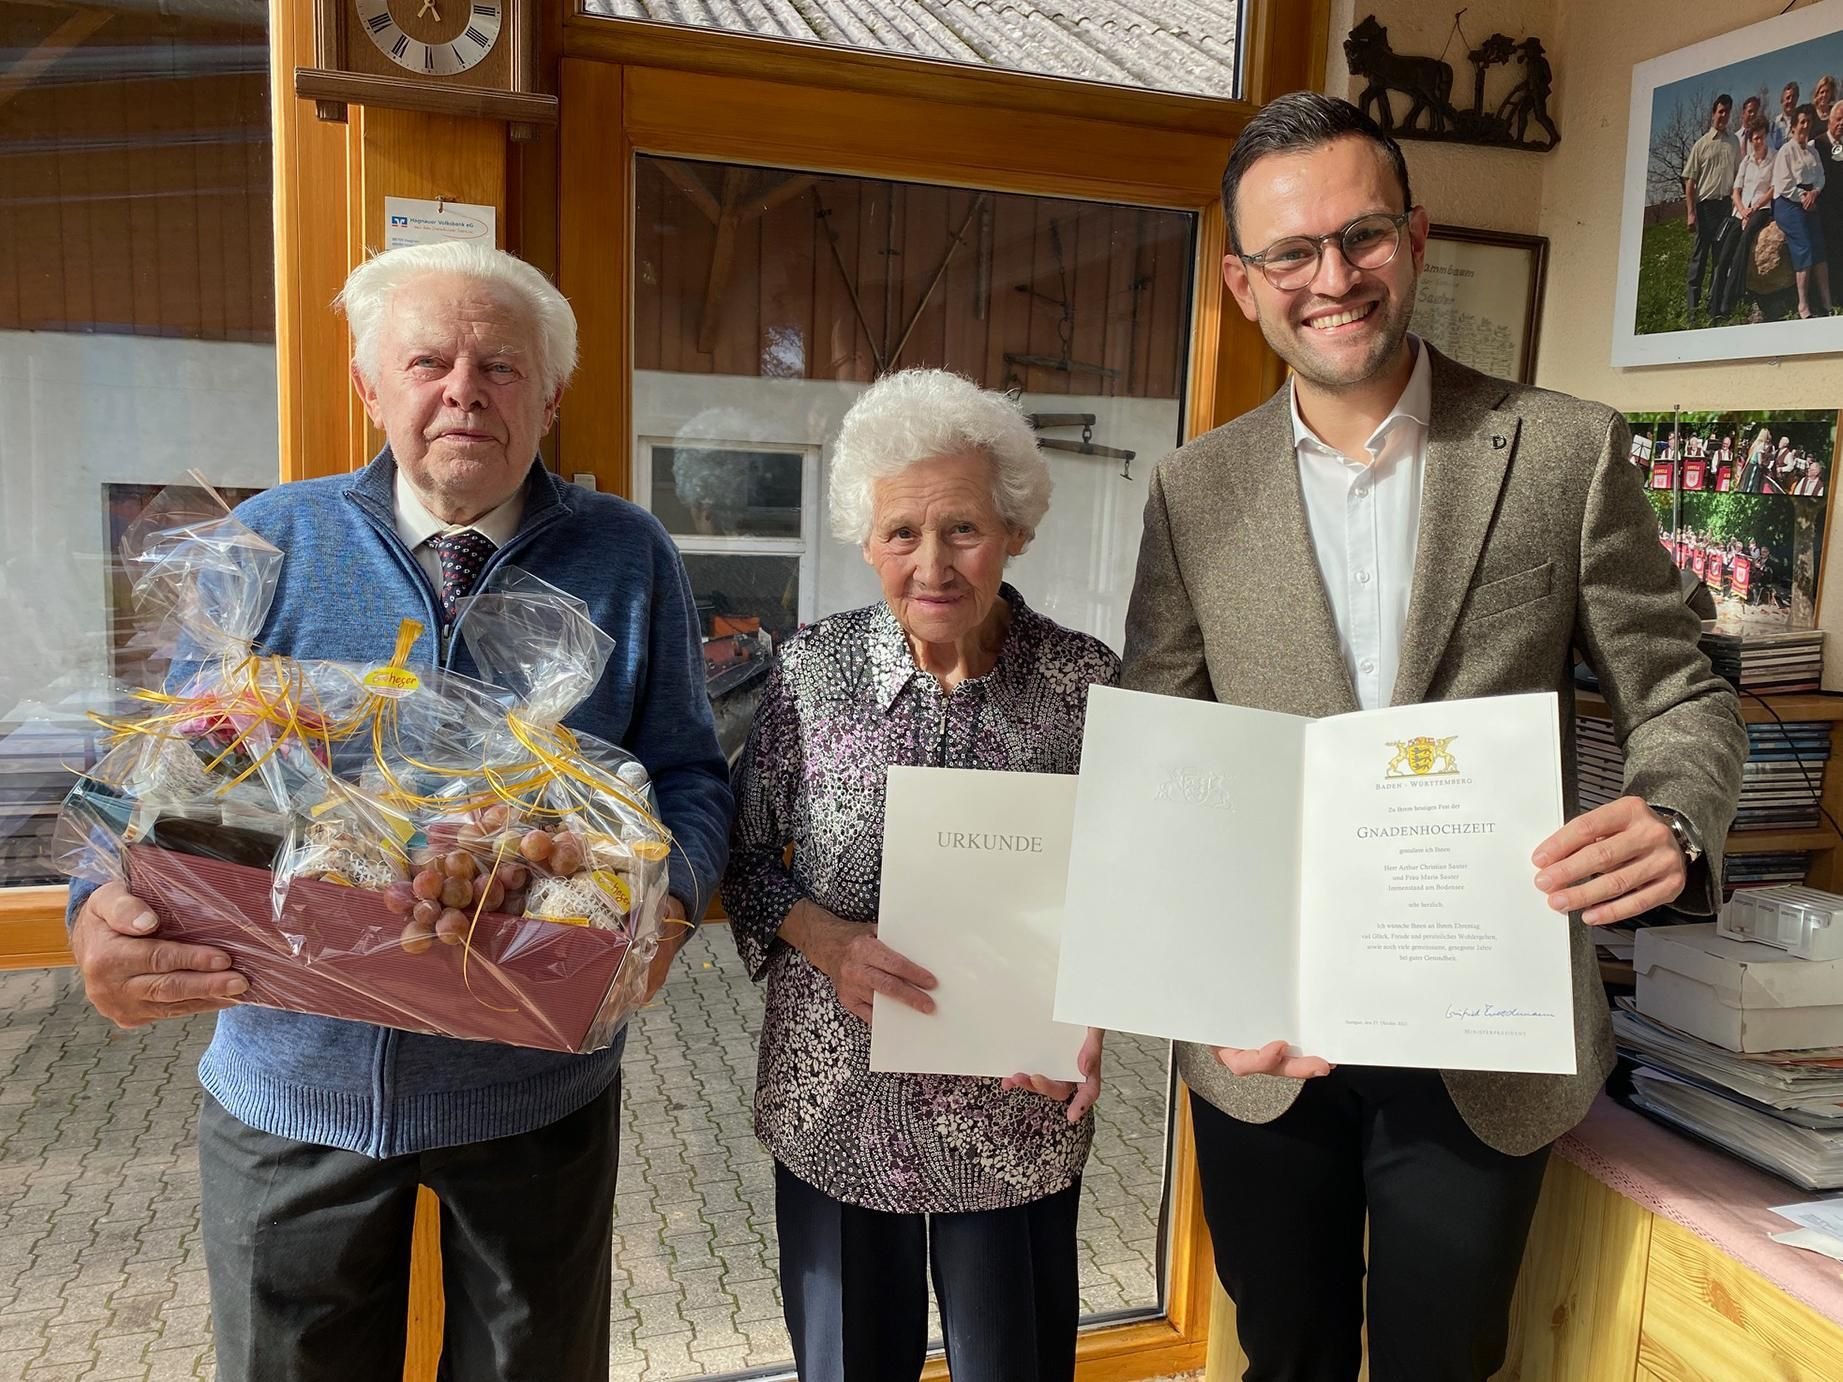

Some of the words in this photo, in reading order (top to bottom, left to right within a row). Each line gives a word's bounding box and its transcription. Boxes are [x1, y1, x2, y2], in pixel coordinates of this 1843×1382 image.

[1376, 782, 1402, 791] BADEN
[1357, 822, 1496, 839] GNADENHOCHZEIT
[938, 831, 1042, 852] URKUNDE
